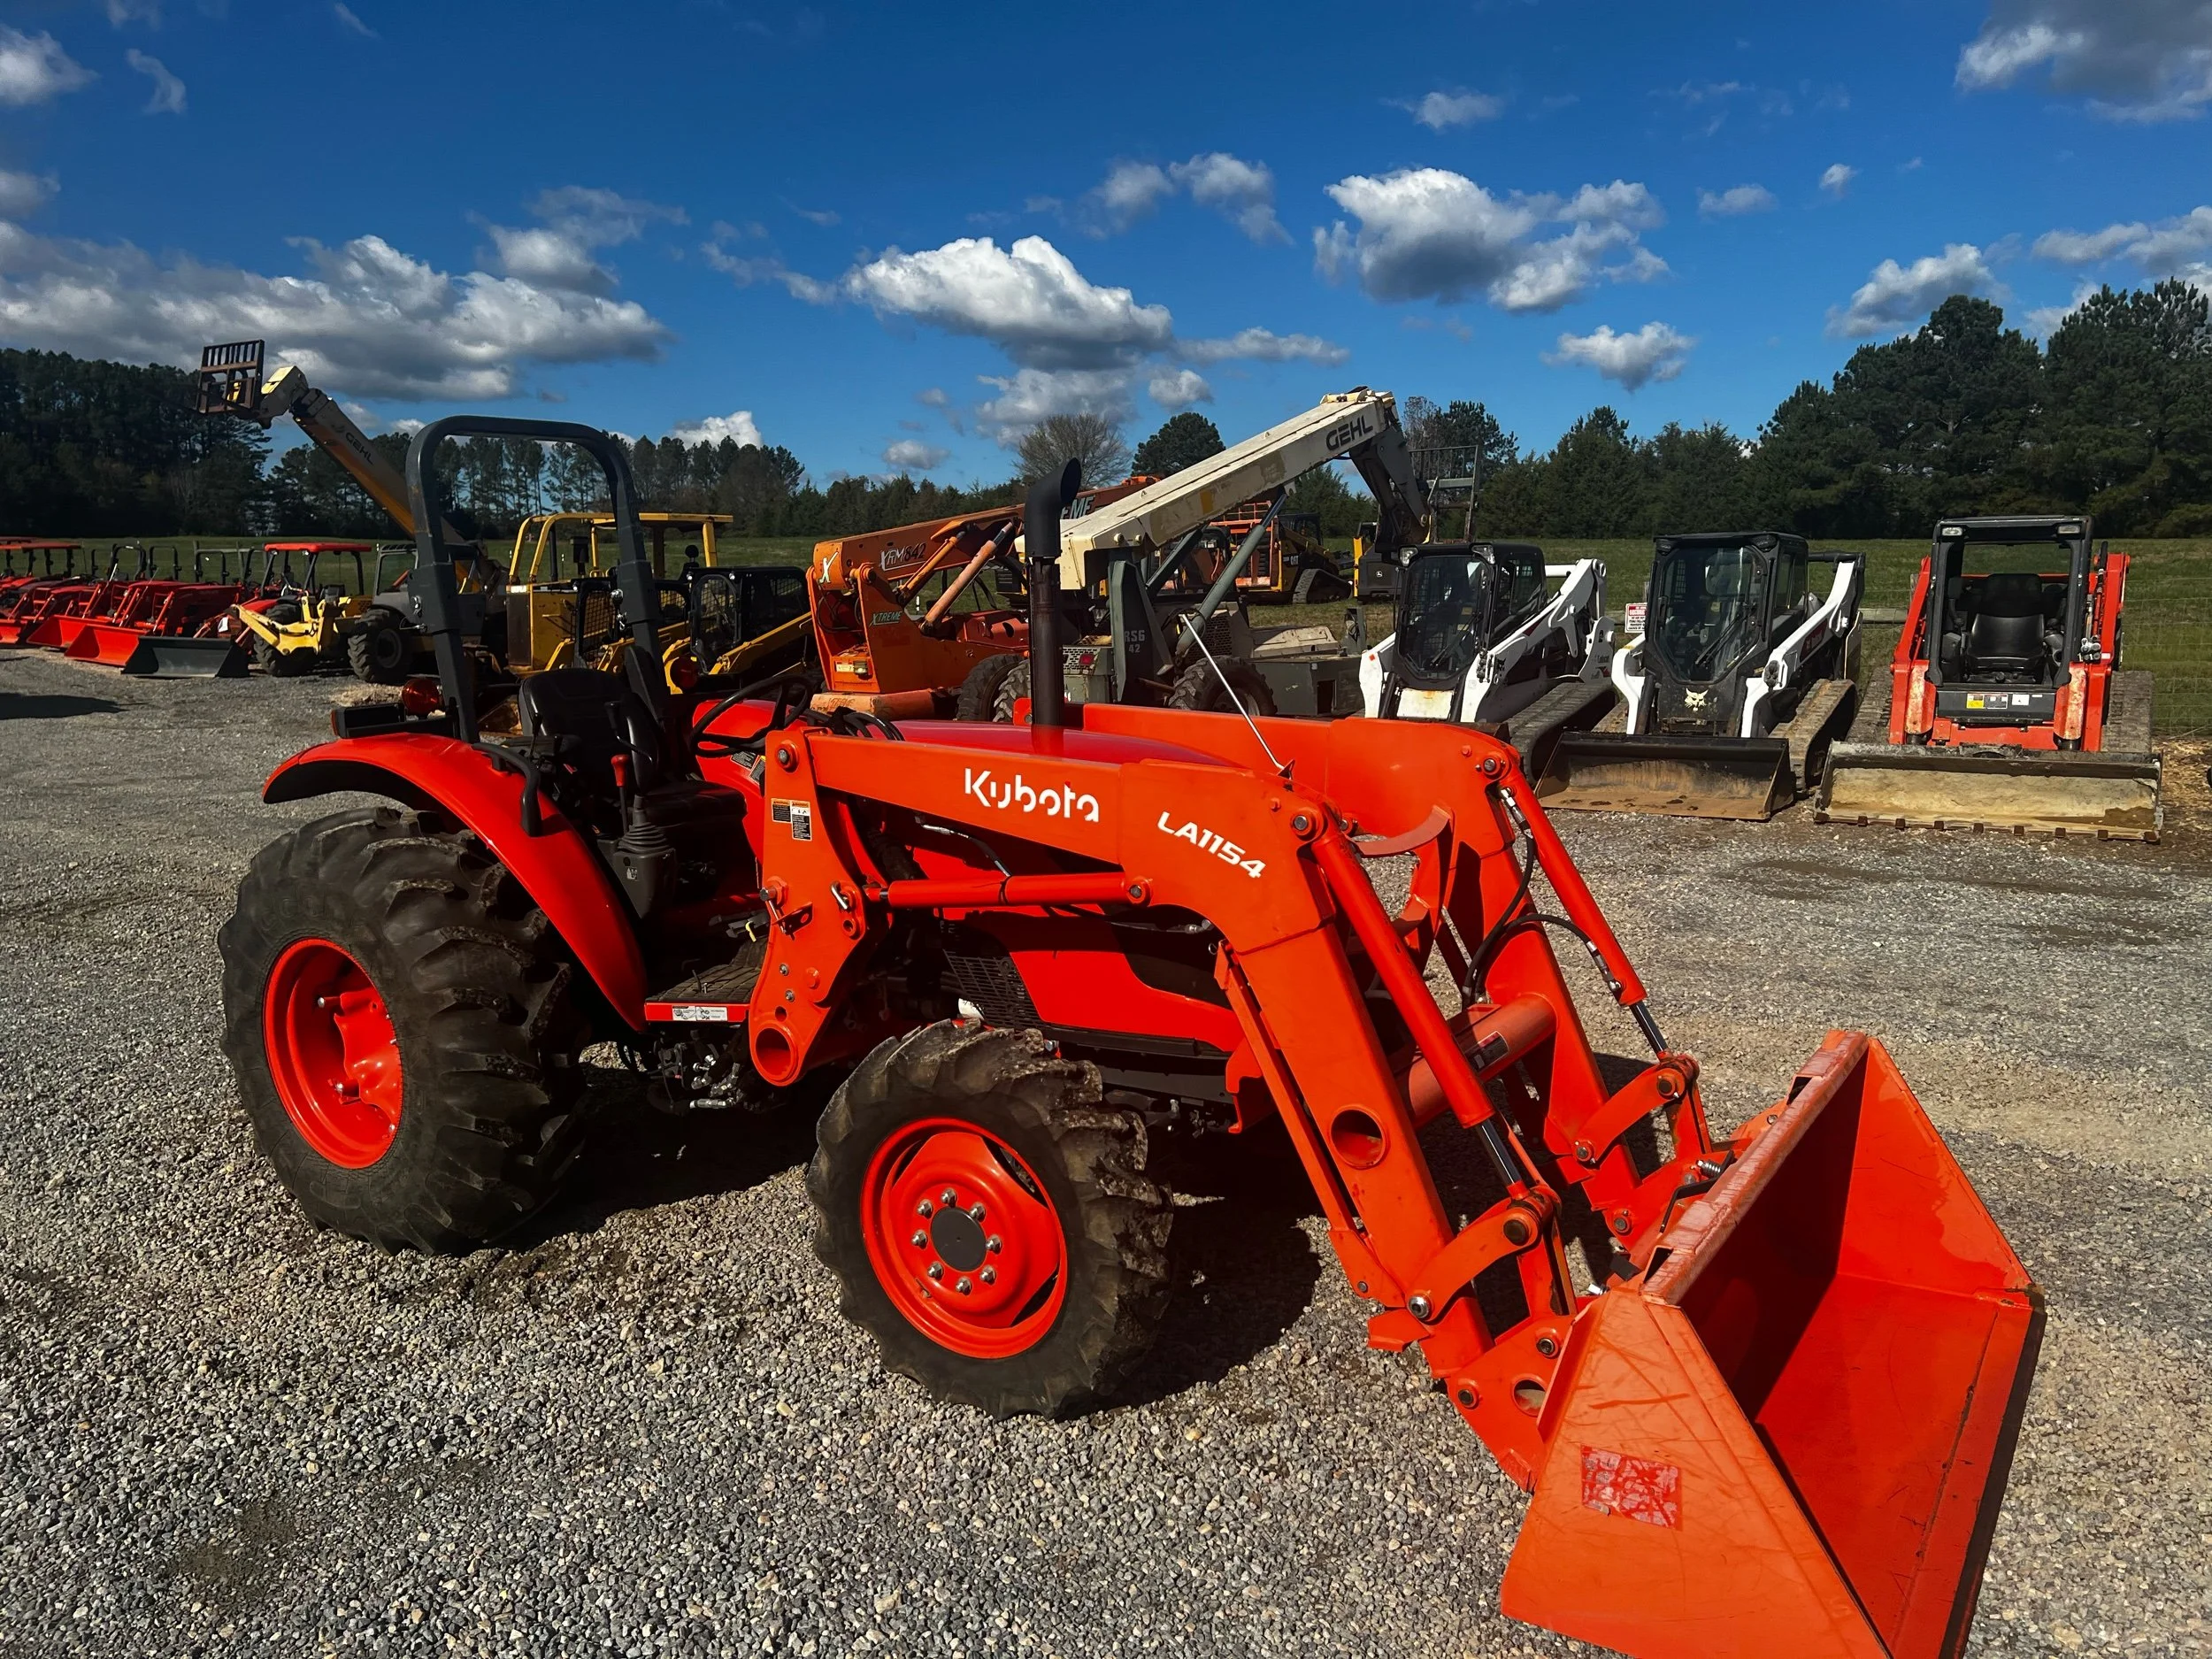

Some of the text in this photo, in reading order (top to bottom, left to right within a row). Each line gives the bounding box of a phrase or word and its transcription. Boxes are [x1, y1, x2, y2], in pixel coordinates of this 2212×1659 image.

[345, 432, 373, 465] GEHL
[1326, 415, 1373, 450] GEHL
[870, 611, 902, 626] XTREME
[1128, 644, 1141, 653] 42
[964, 767, 1099, 823] Kubota
[1157, 810, 1267, 879] LA1154
